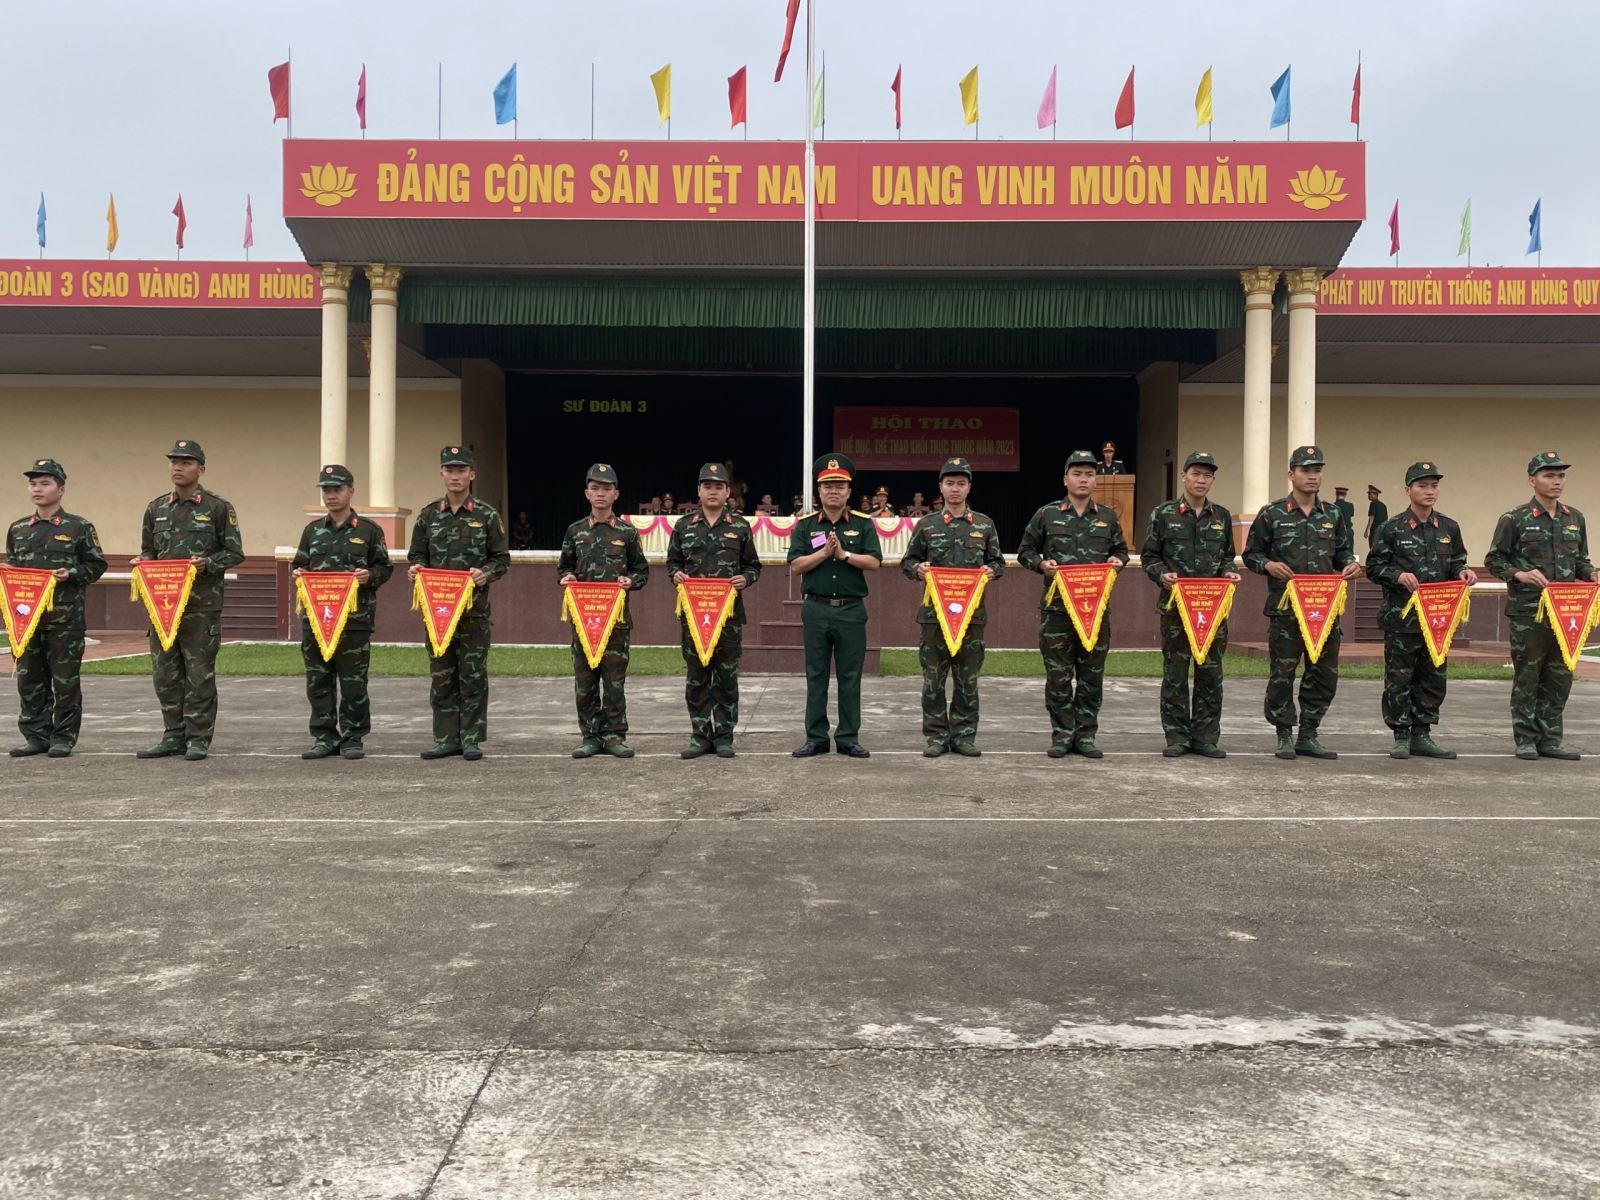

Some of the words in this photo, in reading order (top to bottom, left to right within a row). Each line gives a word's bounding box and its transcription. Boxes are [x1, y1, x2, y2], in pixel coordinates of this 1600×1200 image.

[377, 148, 470, 203] ĐẢNG
[484, 154, 574, 213] CỘNG
[590, 149, 658, 204] SẢN
[672, 155, 742, 213] VIỆT
[758, 165, 836, 204] NAM
[872, 165, 962, 205] UANG
[977, 165, 1055, 205] VINH
[1070, 155, 1171, 205] MUÔN
[1185, 156, 1267, 205] NĂM
[0, 265, 52, 297] ĐOÀN
[60, 271, 73, 297] 3
[82, 270, 129, 298] (SAO
[138, 267, 200, 299] VÀNG)
[208, 273, 250, 299] ANH
[259, 268, 314, 299] HÙNG
[1320, 274, 1353, 305] PHÁT
[1359, 280, 1384, 305] HUY
[1390, 270, 1442, 305] TRUYỀN
[1448, 270, 1492, 305] THỐNG
[1498, 279, 1526, 305] ANH
[1531, 273, 1568, 305] HÙNG
[563, 399, 585, 413] SƯ
[589, 398, 632, 413] ĐOÀN
[637, 400, 647, 413] 3
[871, 414, 913, 432] HỘI
[918, 417, 984, 430] THAO
[995, 439, 1014, 455] 2023
